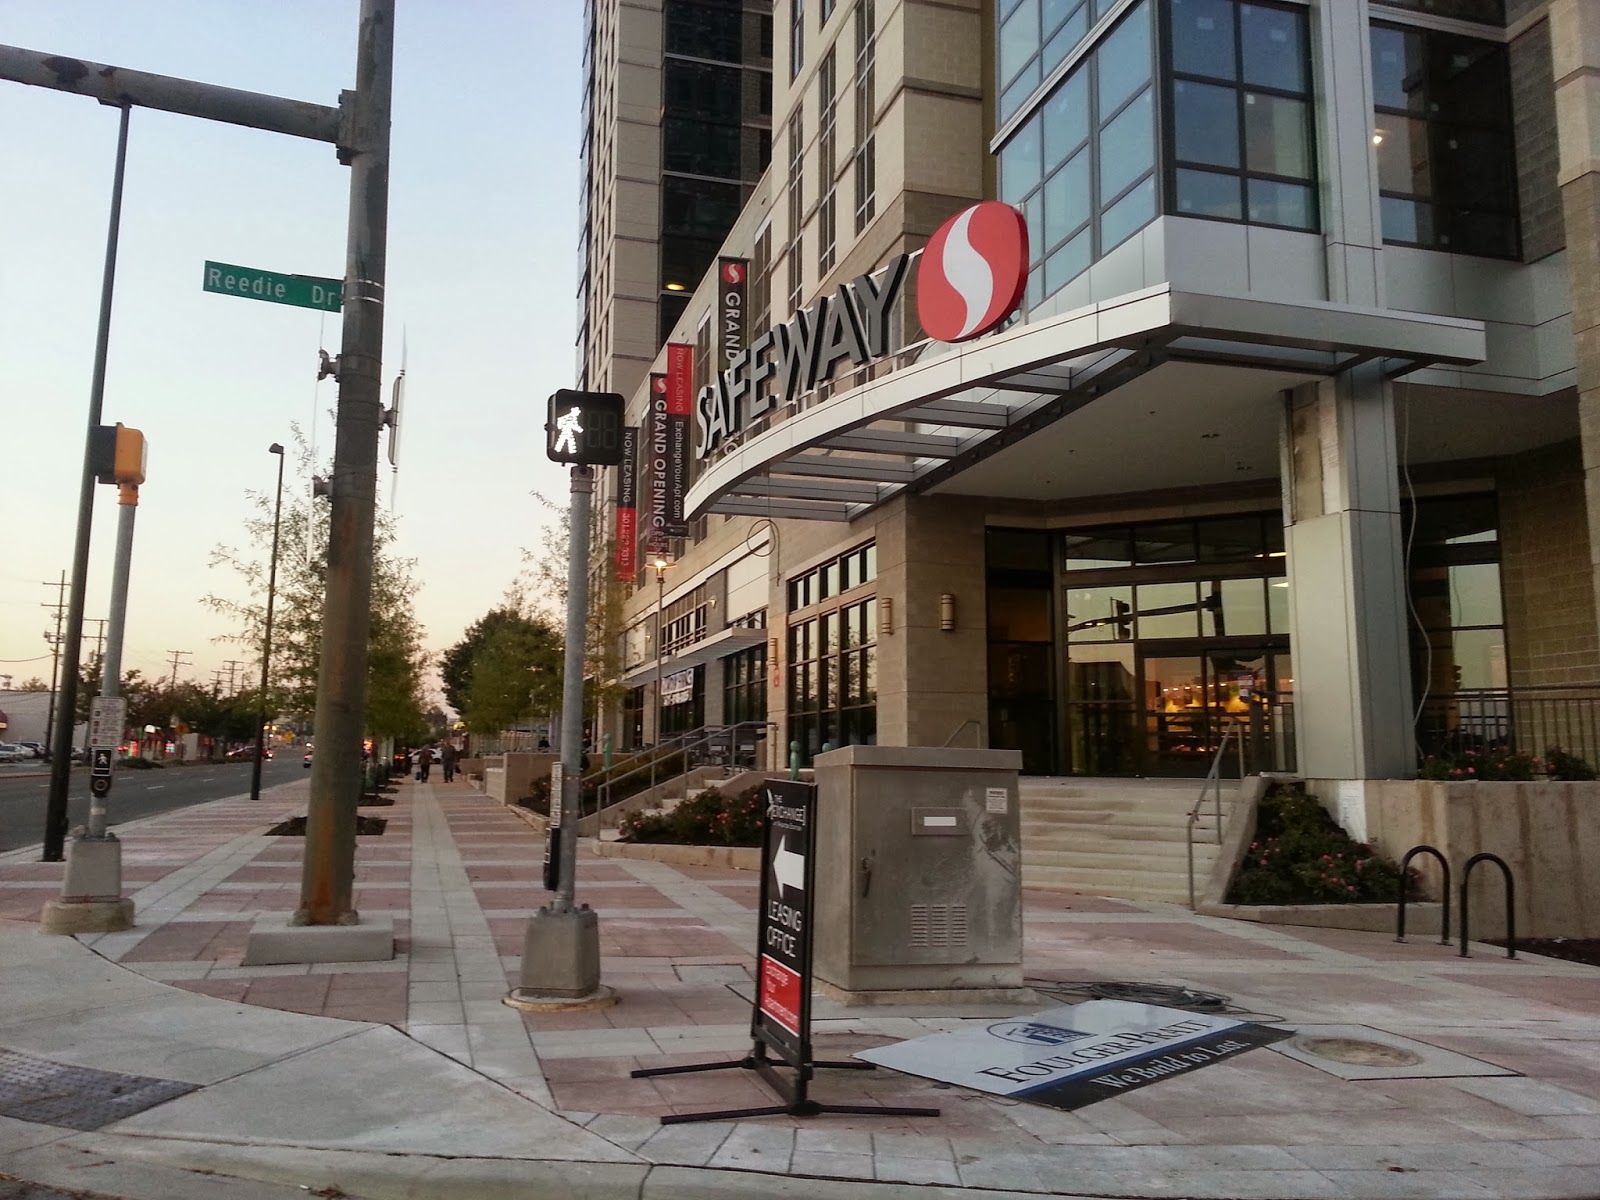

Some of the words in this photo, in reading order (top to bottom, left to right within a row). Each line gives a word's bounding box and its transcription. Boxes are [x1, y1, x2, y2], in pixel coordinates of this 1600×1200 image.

[207, 267, 286, 298] Reedie
[311, 285, 337, 306] Dr
[725, 291, 742, 361] GRAND
[676, 347, 684, 369] NOW
[696, 253, 910, 460] SAFEWAY
[676, 372, 684, 412] LEASING
[624, 432, 633, 456] NOW
[654, 399, 668, 454] GRAND
[623, 458, 633, 503] LEASING
[652, 458, 667, 528] OPENING
[767, 899, 803, 932] LEASING
[766, 926, 797, 958] OFFICE
[1088, 1073, 1141, 1089] We
[1128, 1055, 1193, 1079] Build
[1179, 1052, 1211, 1063] to
